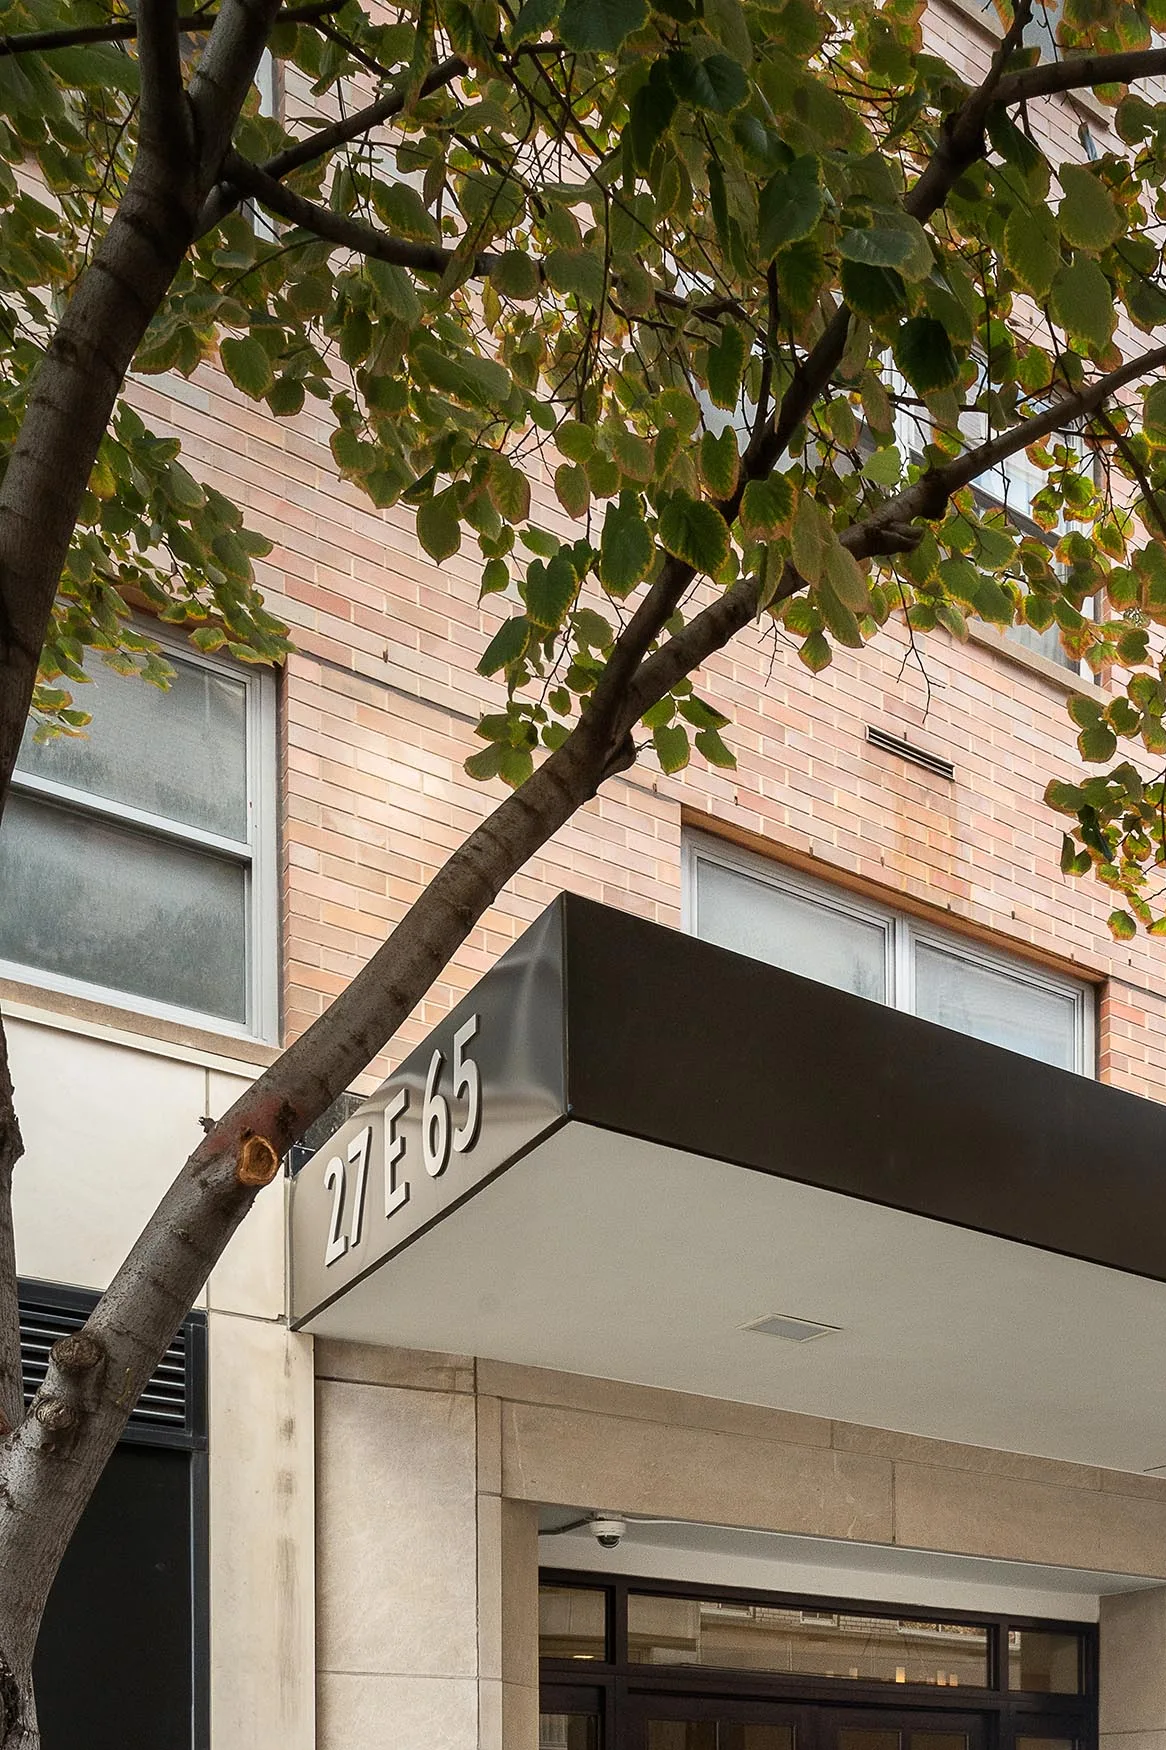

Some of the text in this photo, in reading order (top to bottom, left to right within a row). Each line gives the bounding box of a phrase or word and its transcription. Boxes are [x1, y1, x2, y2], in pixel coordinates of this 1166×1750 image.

[324, 1013, 483, 1267] 27 E 65
